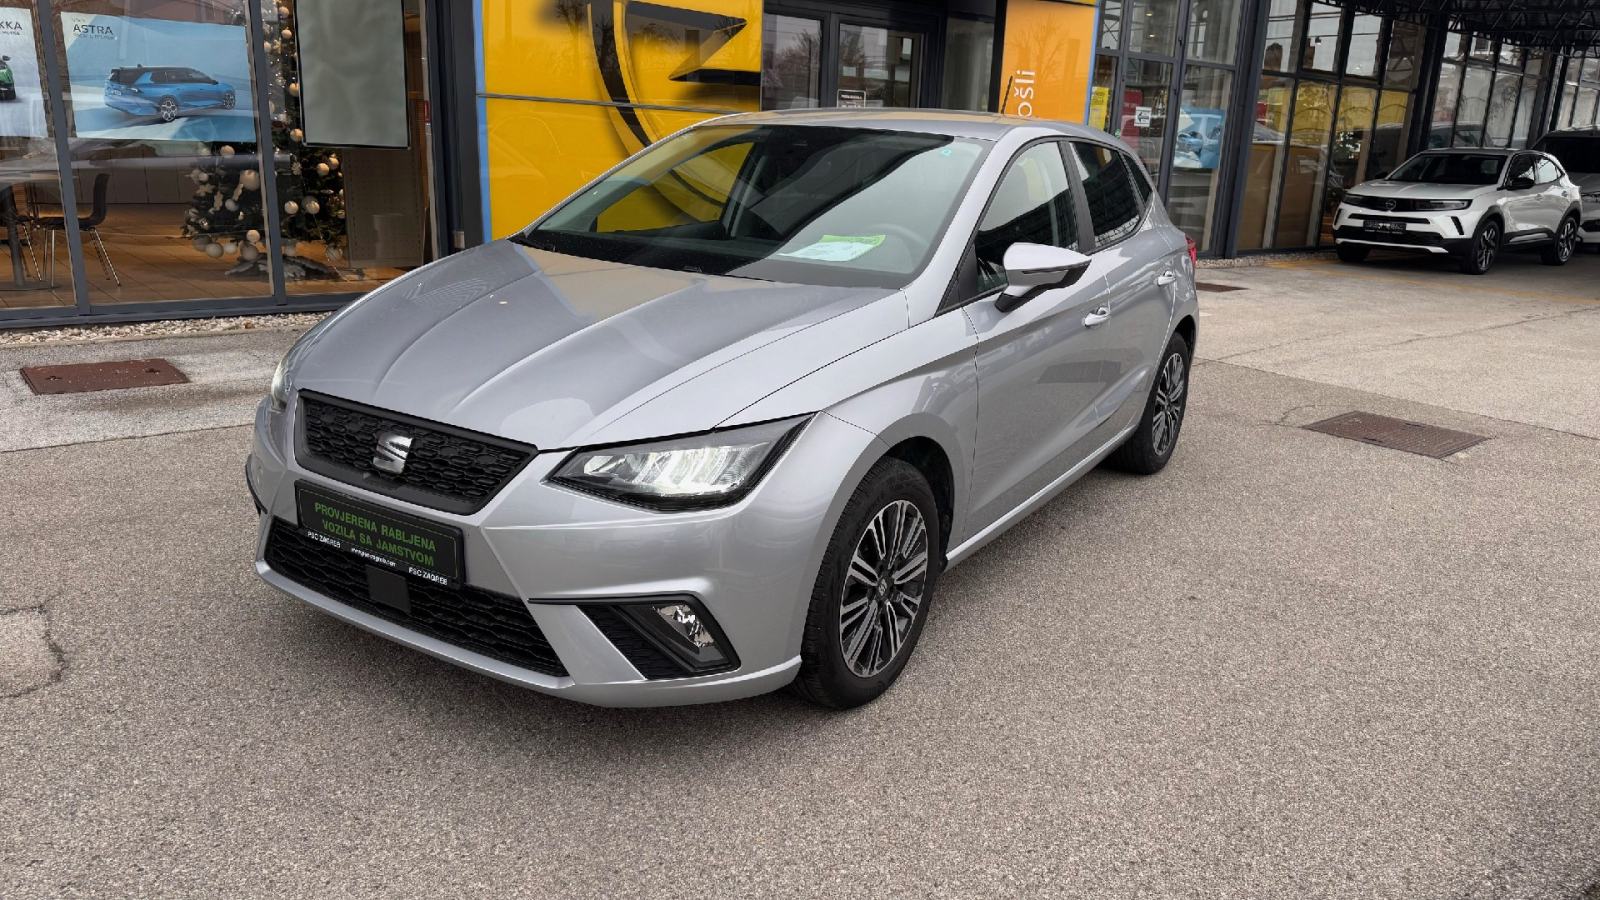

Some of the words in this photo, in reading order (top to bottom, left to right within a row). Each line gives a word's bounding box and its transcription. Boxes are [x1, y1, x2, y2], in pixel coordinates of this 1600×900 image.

[73, 24, 114, 35] ASTRA
[314, 502, 378, 533] PROVJERENA
[381, 524, 436, 552] RABLJENA
[319, 534, 341, 548] ZAGREB
[322, 520, 356, 541] VOZILA
[359, 533, 373, 547] SA
[376, 540, 434, 567] JAMSTVOM
[422, 570, 448, 586] ZAGREB
